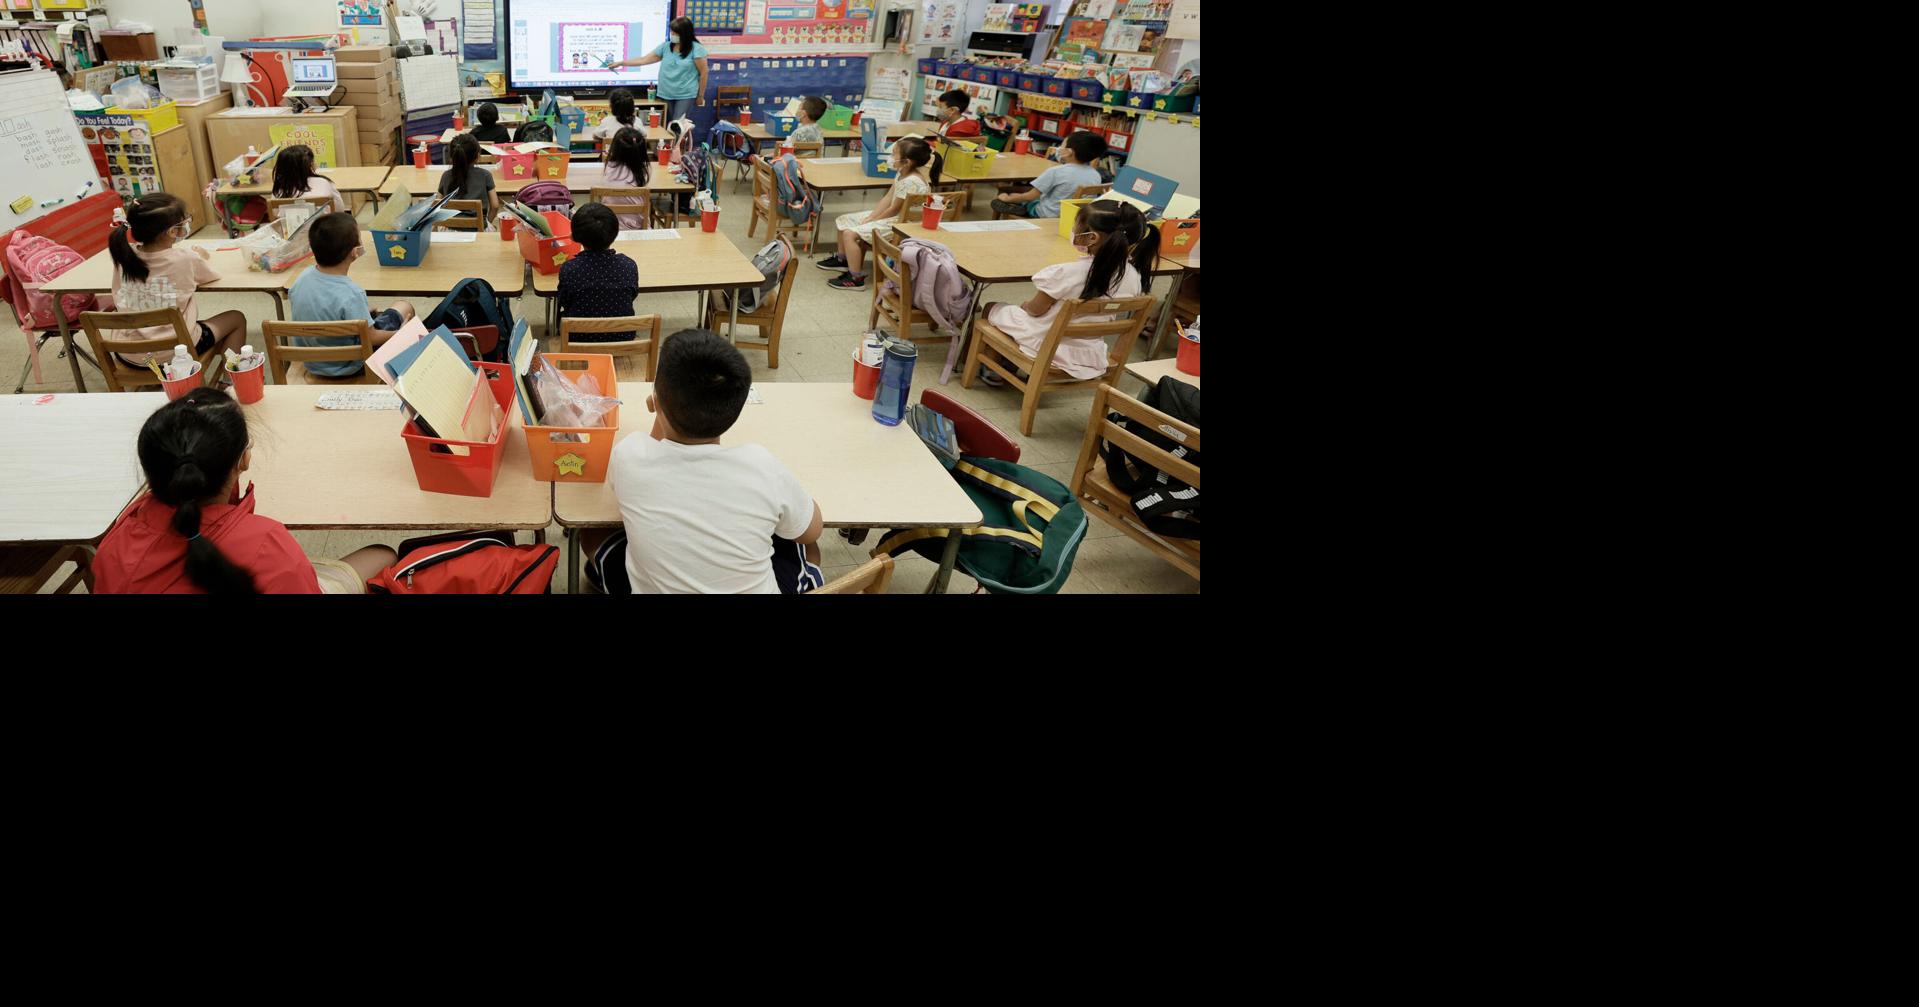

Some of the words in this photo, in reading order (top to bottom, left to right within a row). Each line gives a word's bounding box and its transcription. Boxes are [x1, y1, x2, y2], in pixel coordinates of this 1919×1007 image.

[85, 117, 97, 125] You
[97, 116, 110, 125] Feel
[110, 115, 132, 126] Today?
[286, 131, 317, 139] COOL
